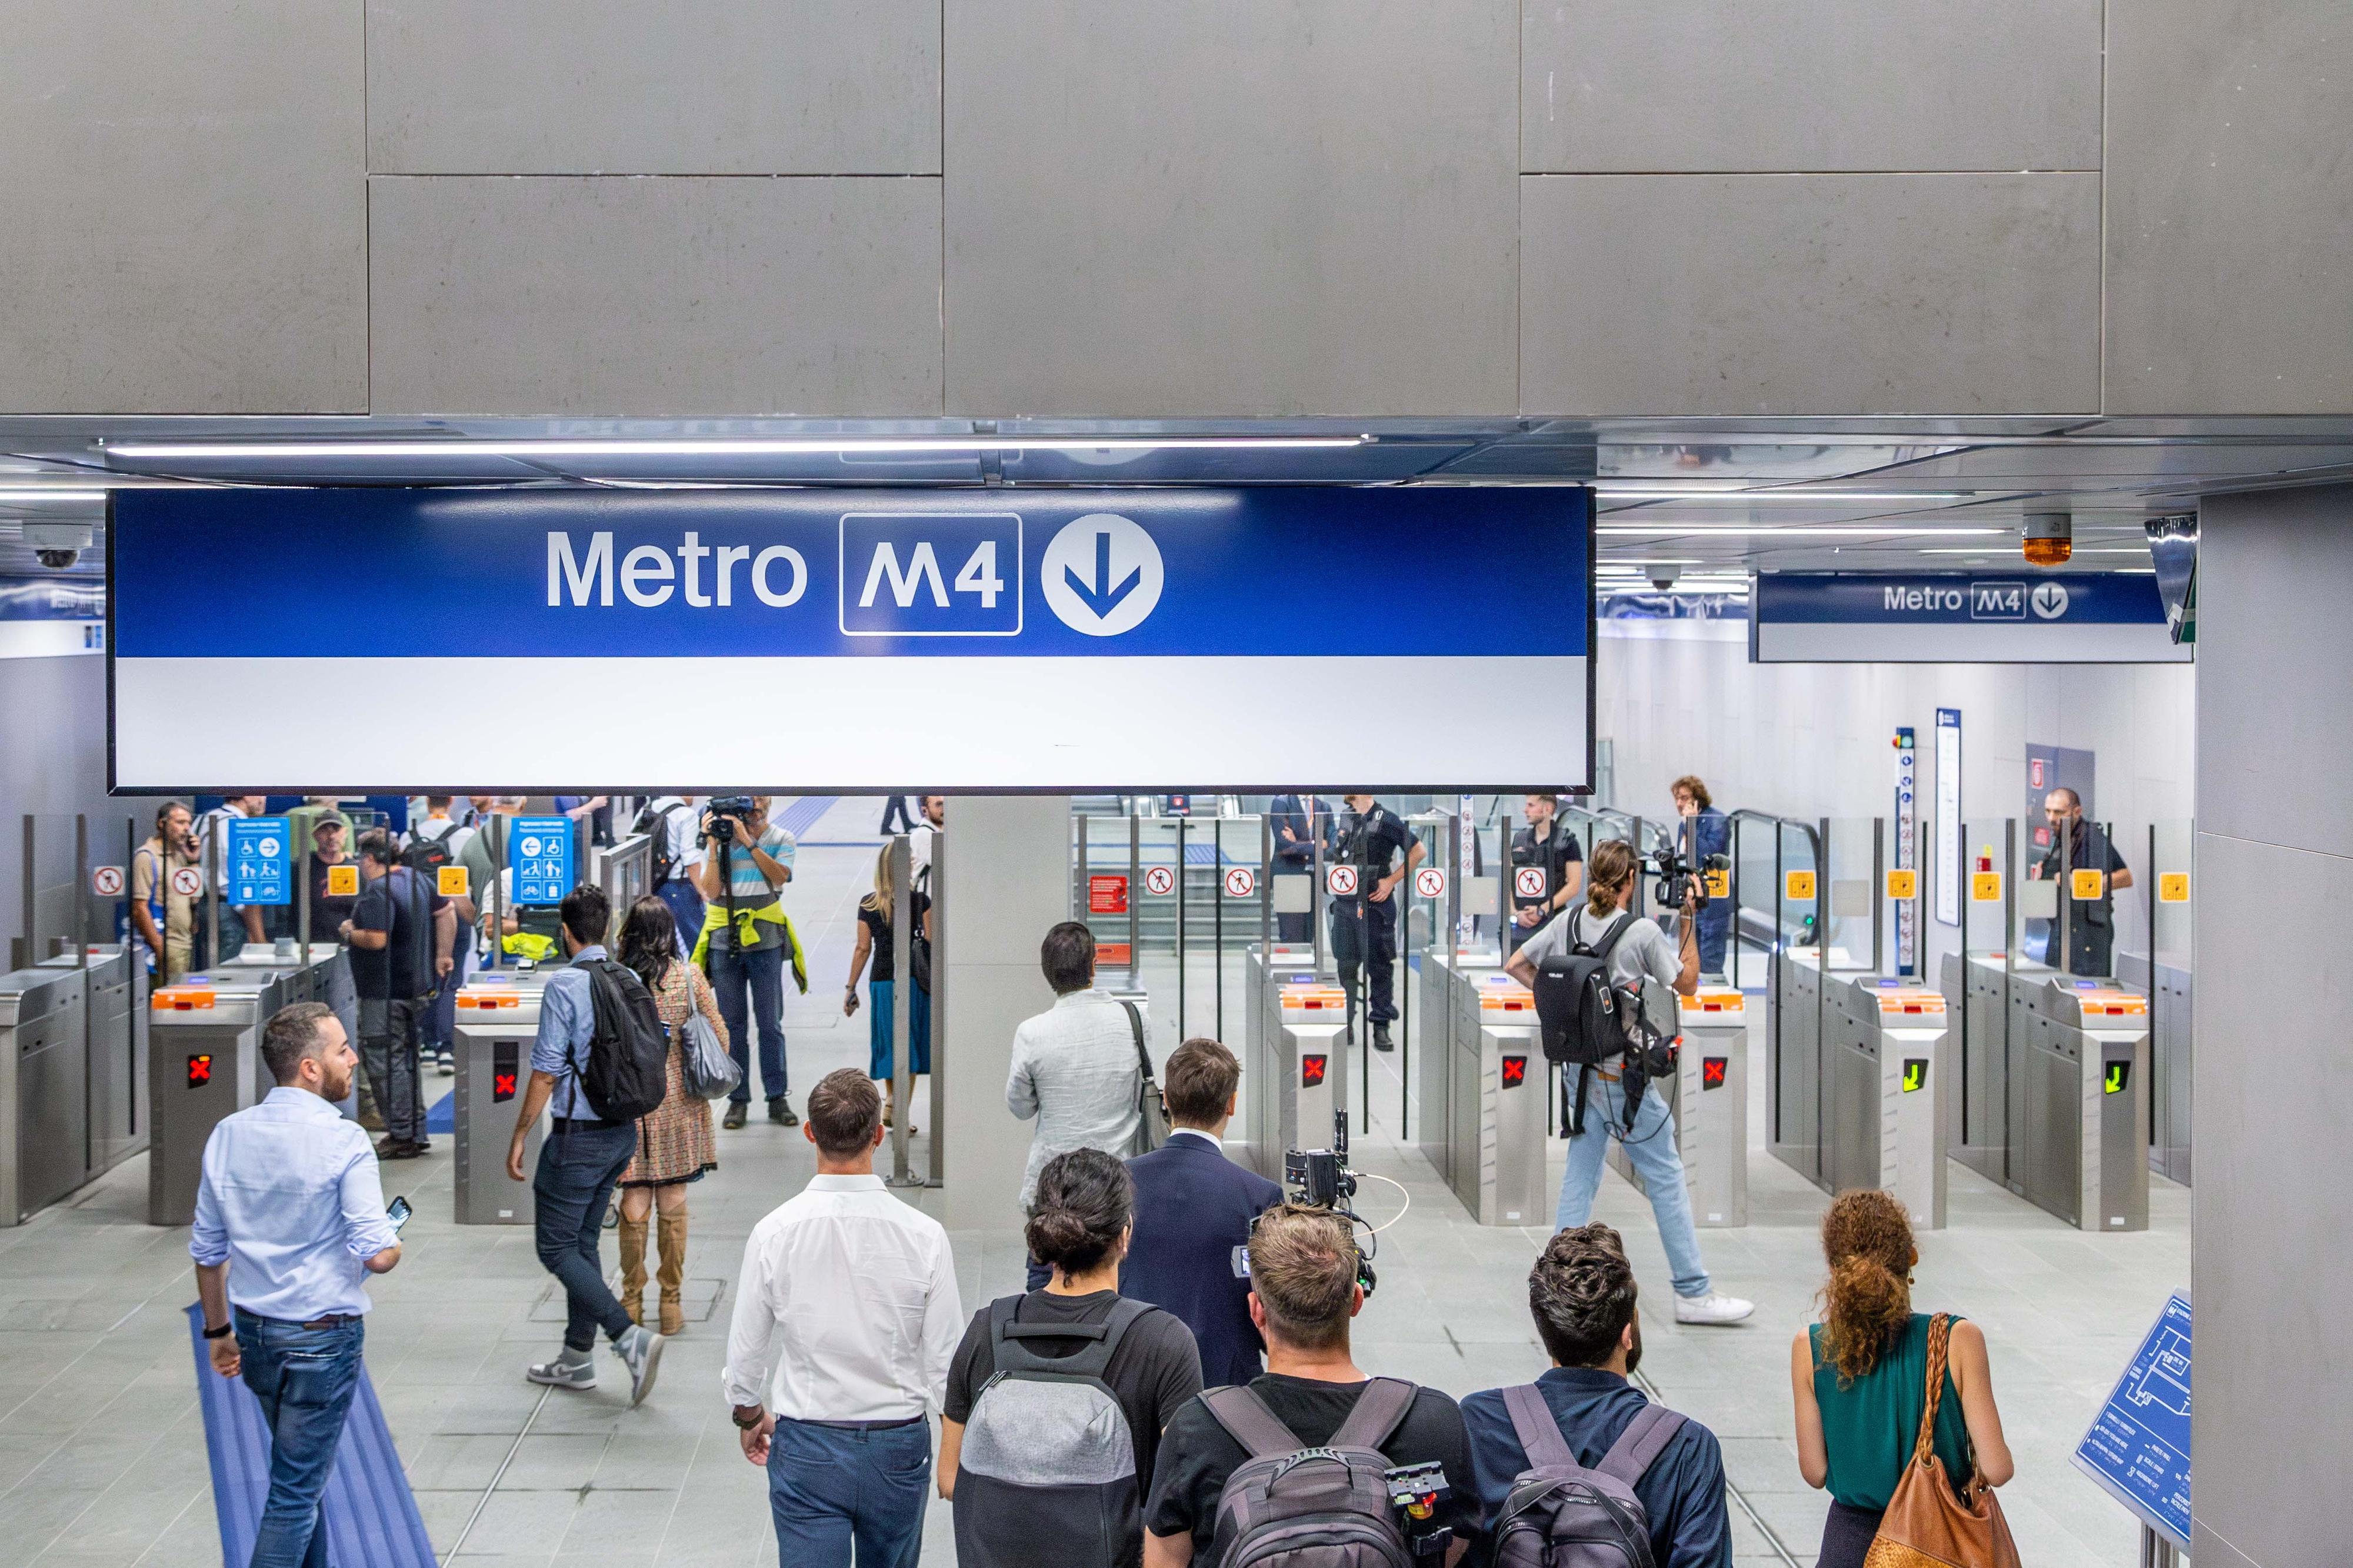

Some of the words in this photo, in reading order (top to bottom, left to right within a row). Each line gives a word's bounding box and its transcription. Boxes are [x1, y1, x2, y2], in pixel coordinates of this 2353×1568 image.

[548, 531, 808, 608] Metro
[858, 541, 1004, 608] M4
[1884, 586, 1961, 610] Metro
[1975, 588, 2021, 612] M4
